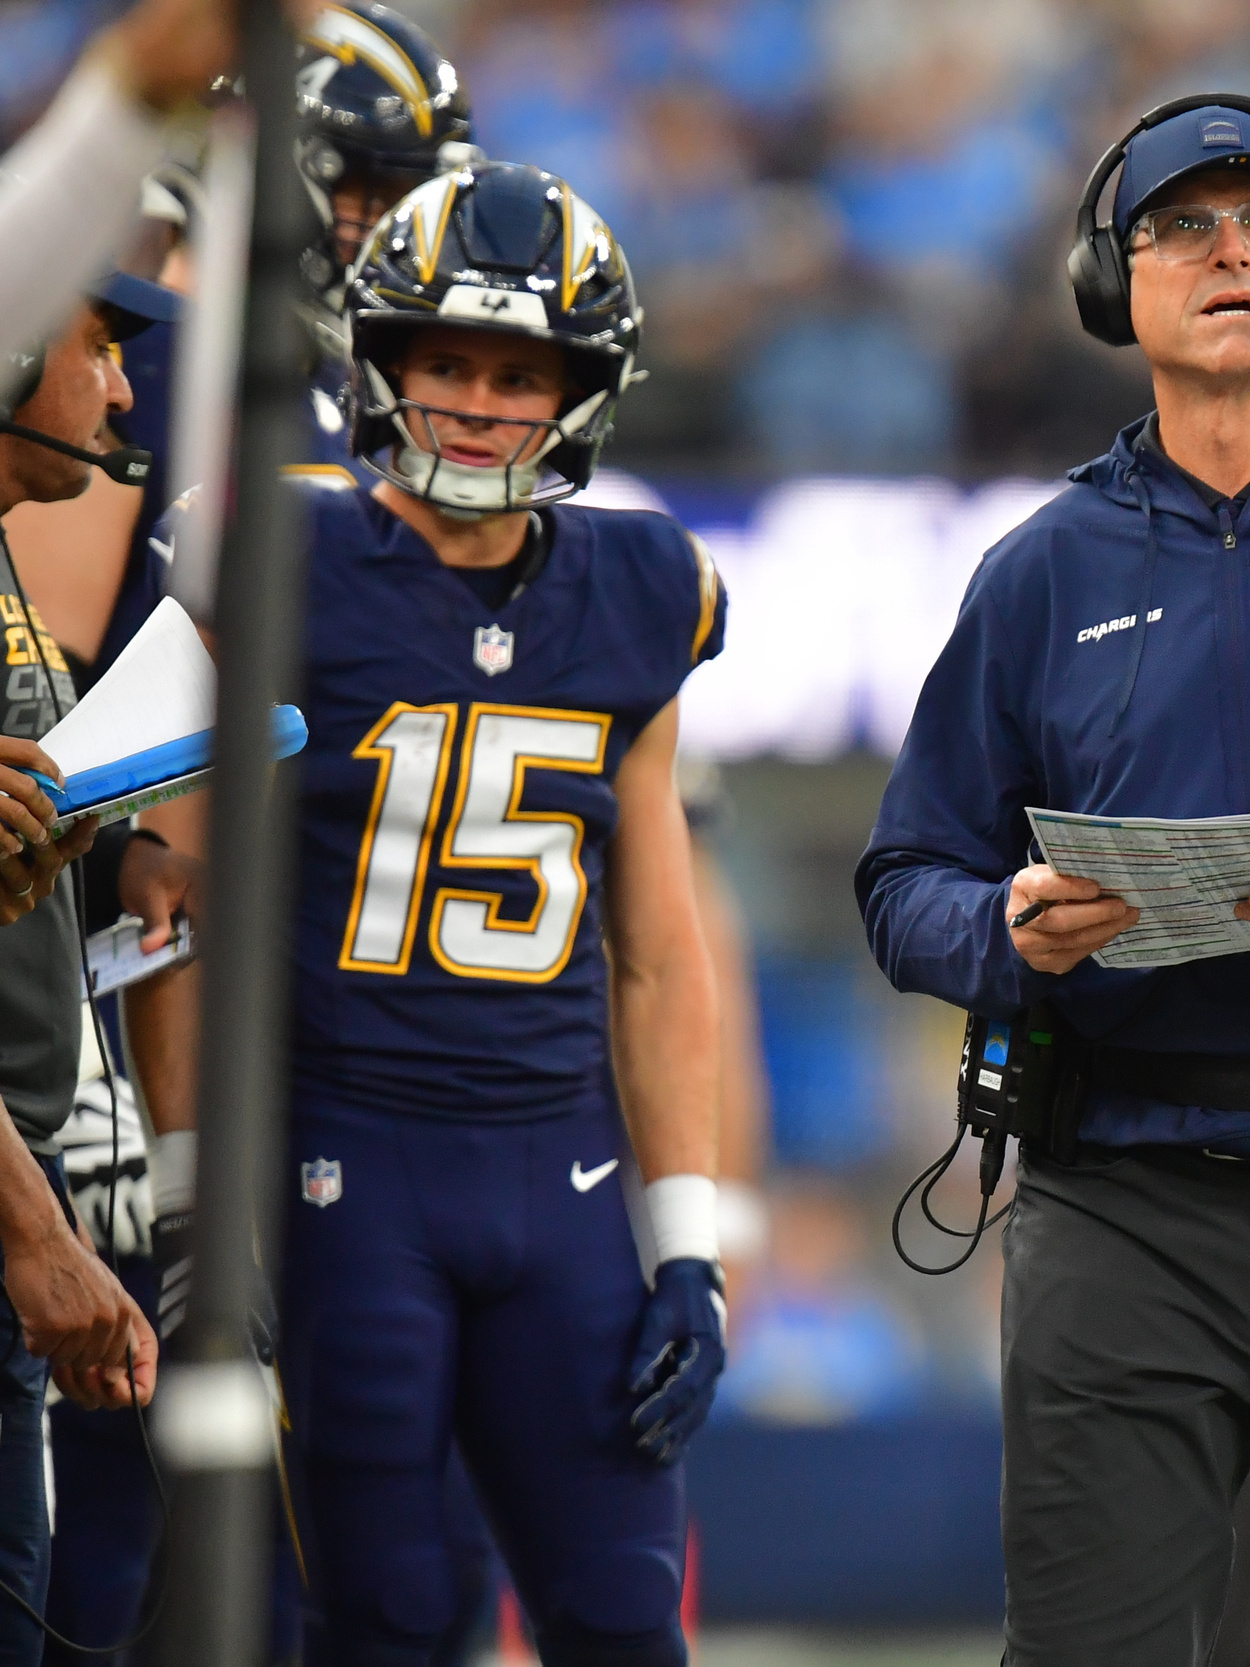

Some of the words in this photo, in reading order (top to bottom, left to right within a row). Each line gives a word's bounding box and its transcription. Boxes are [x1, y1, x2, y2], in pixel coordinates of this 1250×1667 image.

[481, 293, 510, 315] LA
[338, 701, 613, 984] 15
[960, 1012, 975, 1082] ONY
